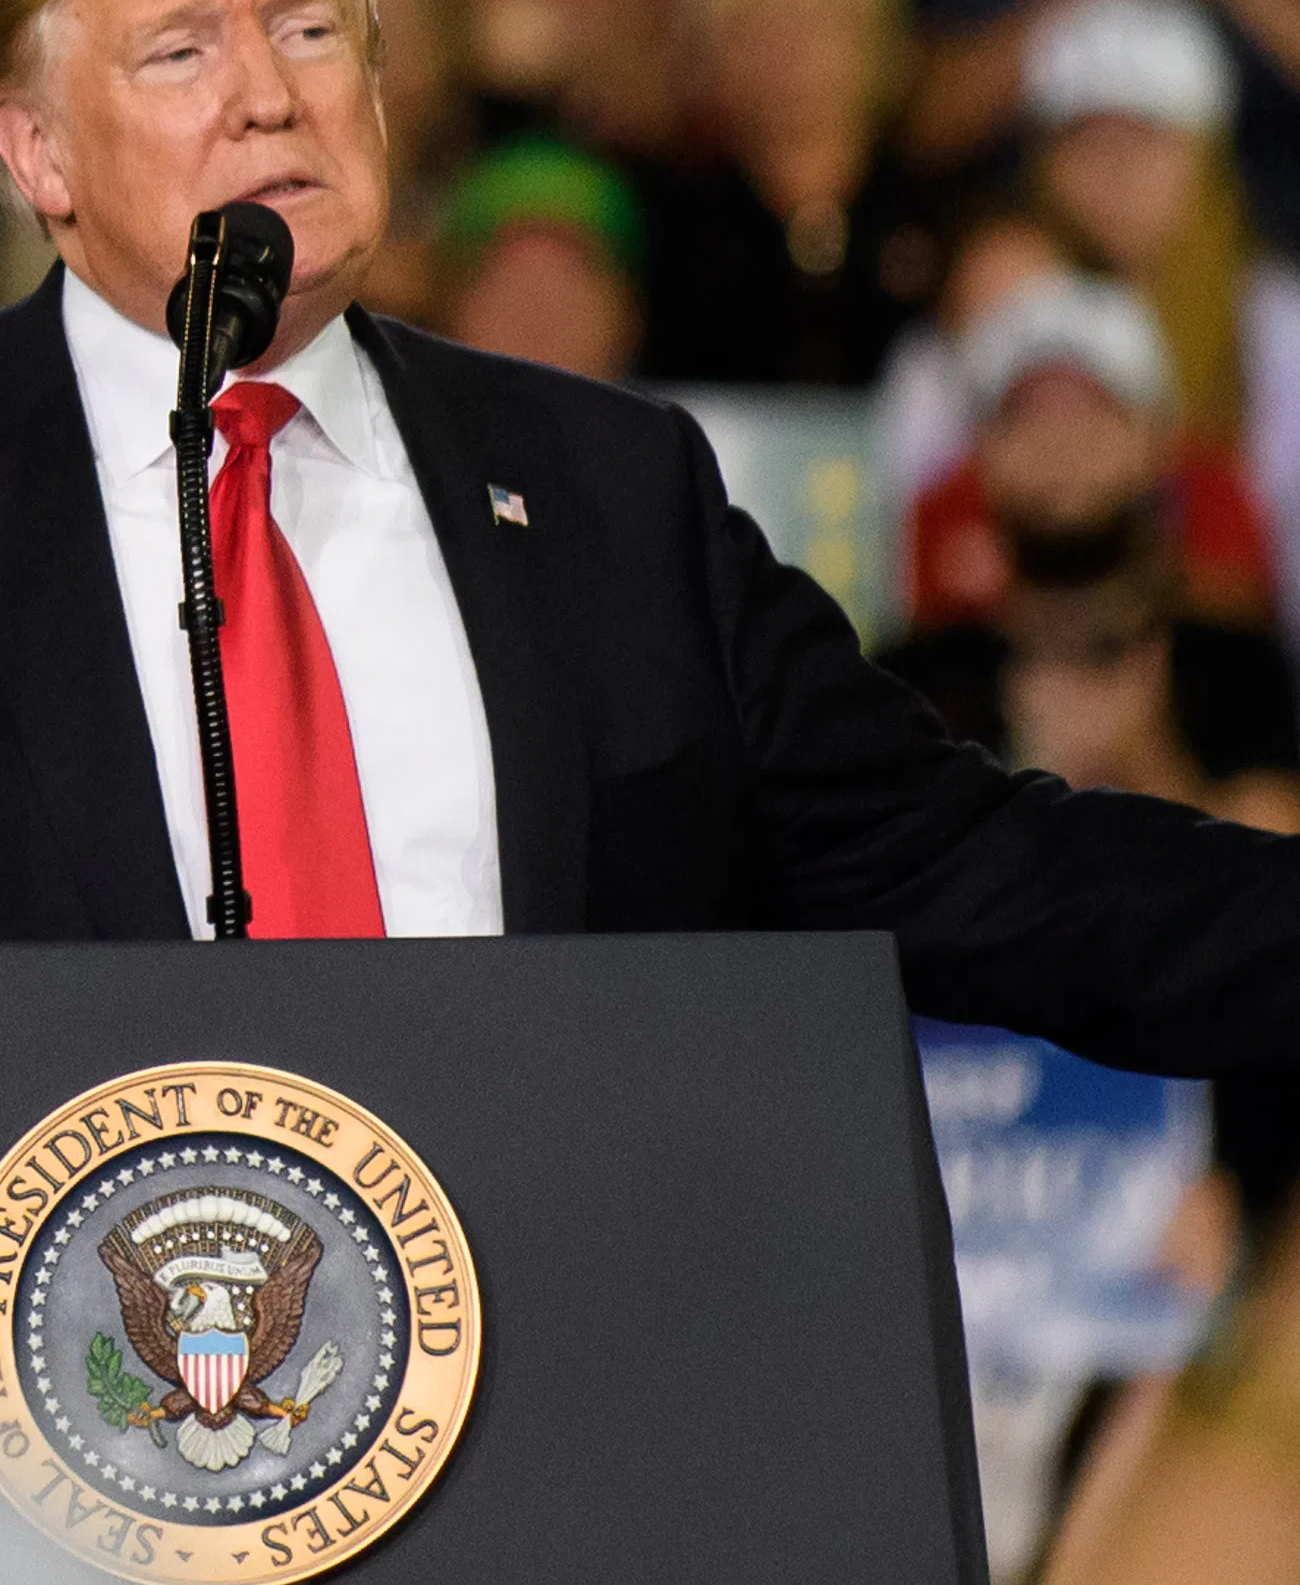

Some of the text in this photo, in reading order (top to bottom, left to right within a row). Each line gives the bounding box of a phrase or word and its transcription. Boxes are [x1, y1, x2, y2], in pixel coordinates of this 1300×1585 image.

[216, 1087, 263, 1119] OF
[274, 1097, 339, 1148] THE
[352, 1142, 463, 1357] UNITED
[29, 1457, 165, 1567] SEAL
[260, 1406, 439, 1567] STATES
